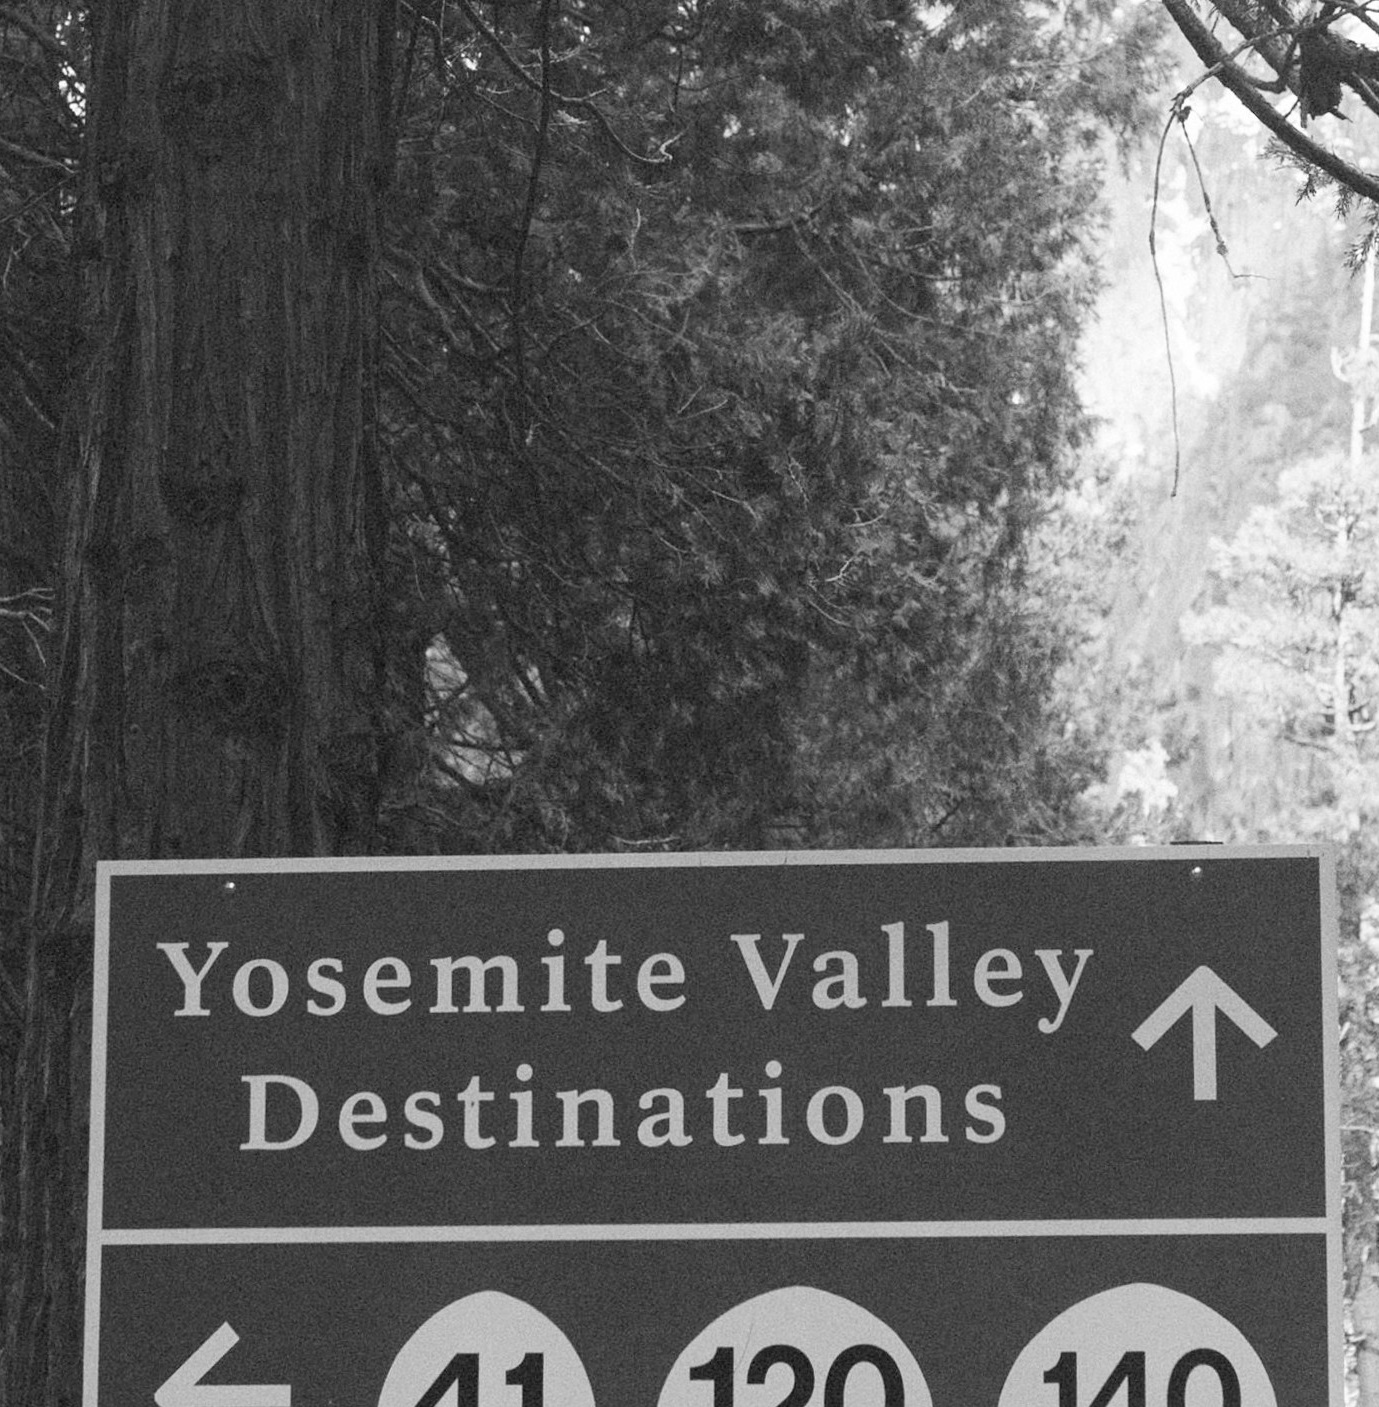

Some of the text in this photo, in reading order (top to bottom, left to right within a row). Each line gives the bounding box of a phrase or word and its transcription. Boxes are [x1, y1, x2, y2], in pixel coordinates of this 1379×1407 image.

[156, 920, 1094, 1034] Yosemite Valley
[239, 1059, 1007, 1151] Destinations
